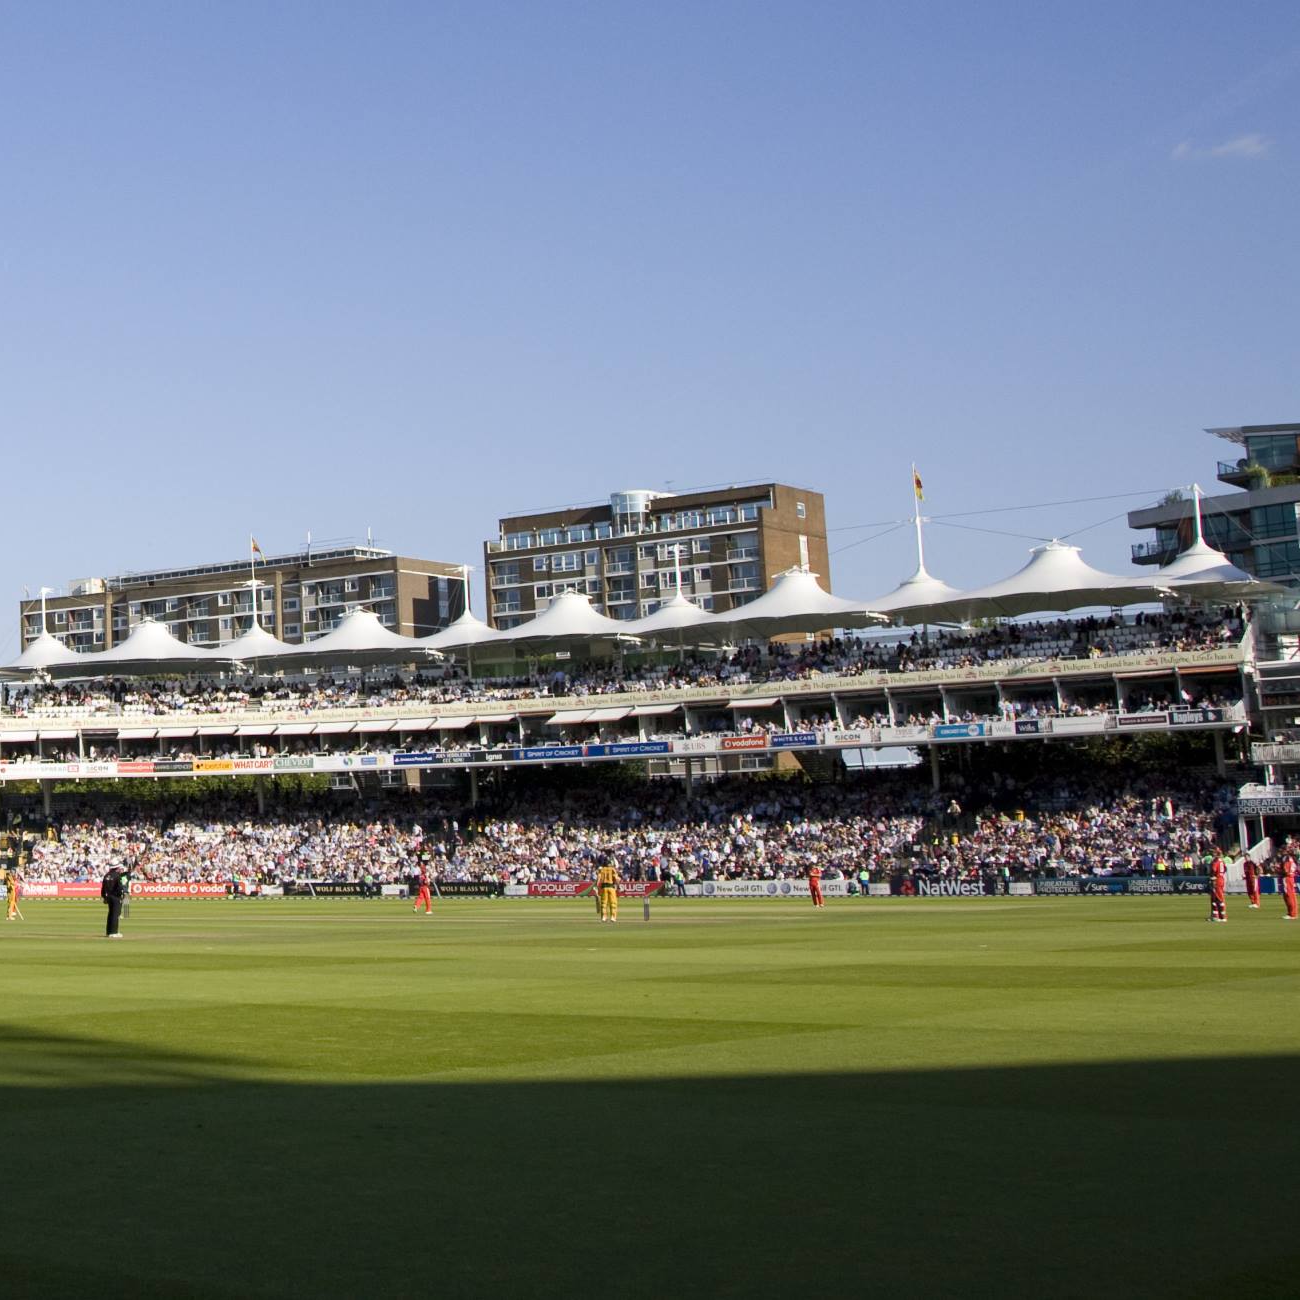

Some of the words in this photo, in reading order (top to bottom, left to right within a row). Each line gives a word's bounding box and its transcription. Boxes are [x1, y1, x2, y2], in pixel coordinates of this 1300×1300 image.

[691, 742, 706, 750] UBS
[731, 738, 764, 747] vodafone
[640, 744, 664, 752] CRICKET
[527, 750, 545, 758] SPIRIT
[555, 749, 578, 757] CRICKET
[234, 760, 252, 769] WHAT
[254, 760, 273, 769] CAR?
[1238, 806, 1295, 814] PROTECTION
[143, 884, 187, 893] vodafone
[531, 883, 581, 892] npower
[716, 885, 733, 893] New
[734, 884, 749, 893] Golf
[793, 885, 809, 893] New
[918, 880, 985, 895] NatWest
